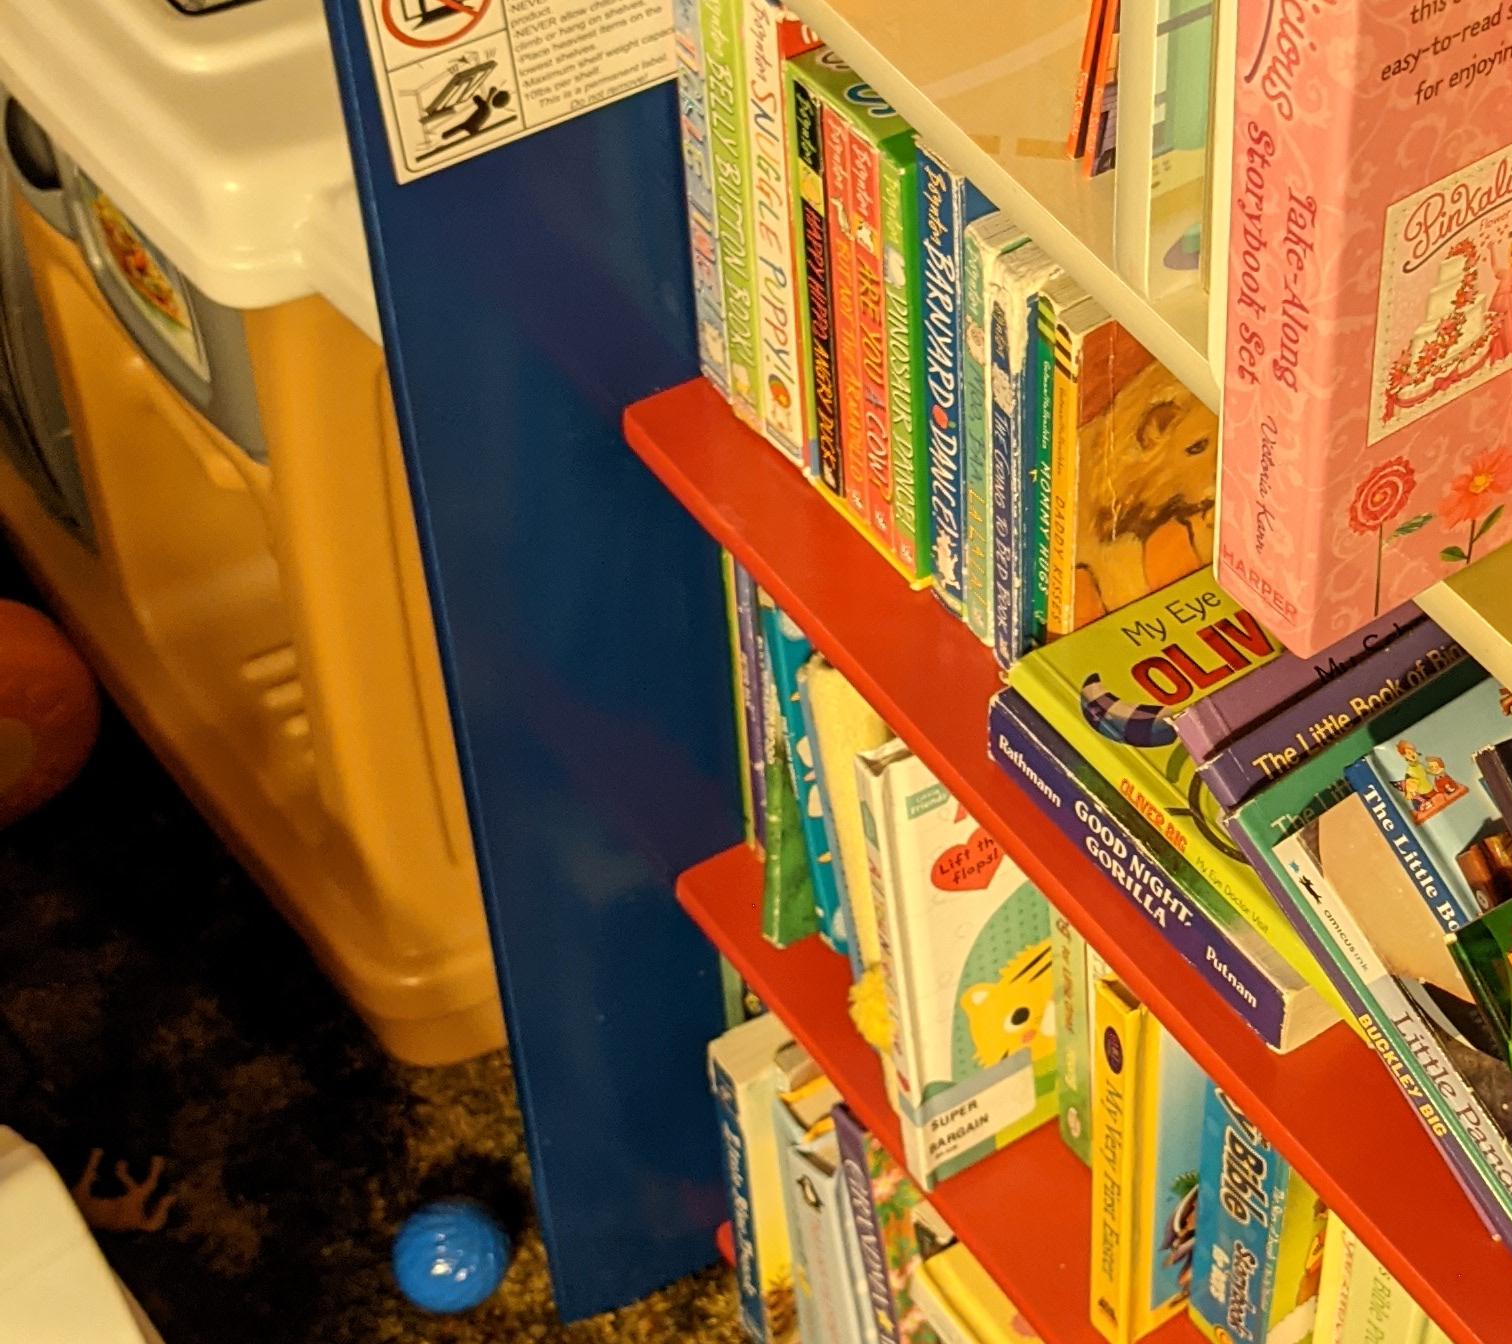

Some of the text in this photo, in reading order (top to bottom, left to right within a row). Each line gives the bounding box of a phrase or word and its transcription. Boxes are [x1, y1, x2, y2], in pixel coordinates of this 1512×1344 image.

[1380, 8, 1503, 83] easy-to-read
[1413, 74, 1440, 106] for
[707, 59, 756, 368] BELLY BUTTON BOOK!
[749, 80, 796, 386] SNUGGLE PUPPY!
[1235, 120, 1277, 387] Storybook Set
[803, 207, 834, 406] HAPPY HIPPO ANGRY
[855, 254, 886, 387] ARE YOU
[1272, 185, 1318, 394] Take-Along
[923, 162, 961, 535] Boynton BARNYARD DANCE!
[886, 287, 918, 535] DINOSAUR DANCE!
[1258, 413, 1279, 499] Victoria
[1035, 459, 1054, 595] MOMMY HUGS
[1051, 493, 1066, 561] DADDY
[1048, 560, 1065, 626] KISSES
[1121, 590, 1224, 648] My Eye
[1222, 542, 1299, 621] HARPER
[1130, 608, 1277, 707] OLIV
[998, 733, 1063, 809] Rathmann
[1252, 675, 1403, 780] The Little Book
[1119, 776, 1167, 832] OLIVER
[1364, 783, 1445, 902] The Little
[939, 849, 974, 878] Lift
[1073, 797, 1197, 929] GOOD NIGHT,
[1083, 834, 1169, 929] GORILLA
[1204, 944, 1259, 1010] Putnam
[1358, 1011, 1449, 1140] BUCKLEY BIG
[1390, 1006, 1459, 1102] Little
[928, 1112, 991, 1156] BARGAIN
[930, 1099, 979, 1134] SUPER
[1099, 1079, 1122, 1284] My First Easter
[1221, 1125, 1268, 1228] Bible
[1368, 1284, 1391, 1330] Bible
